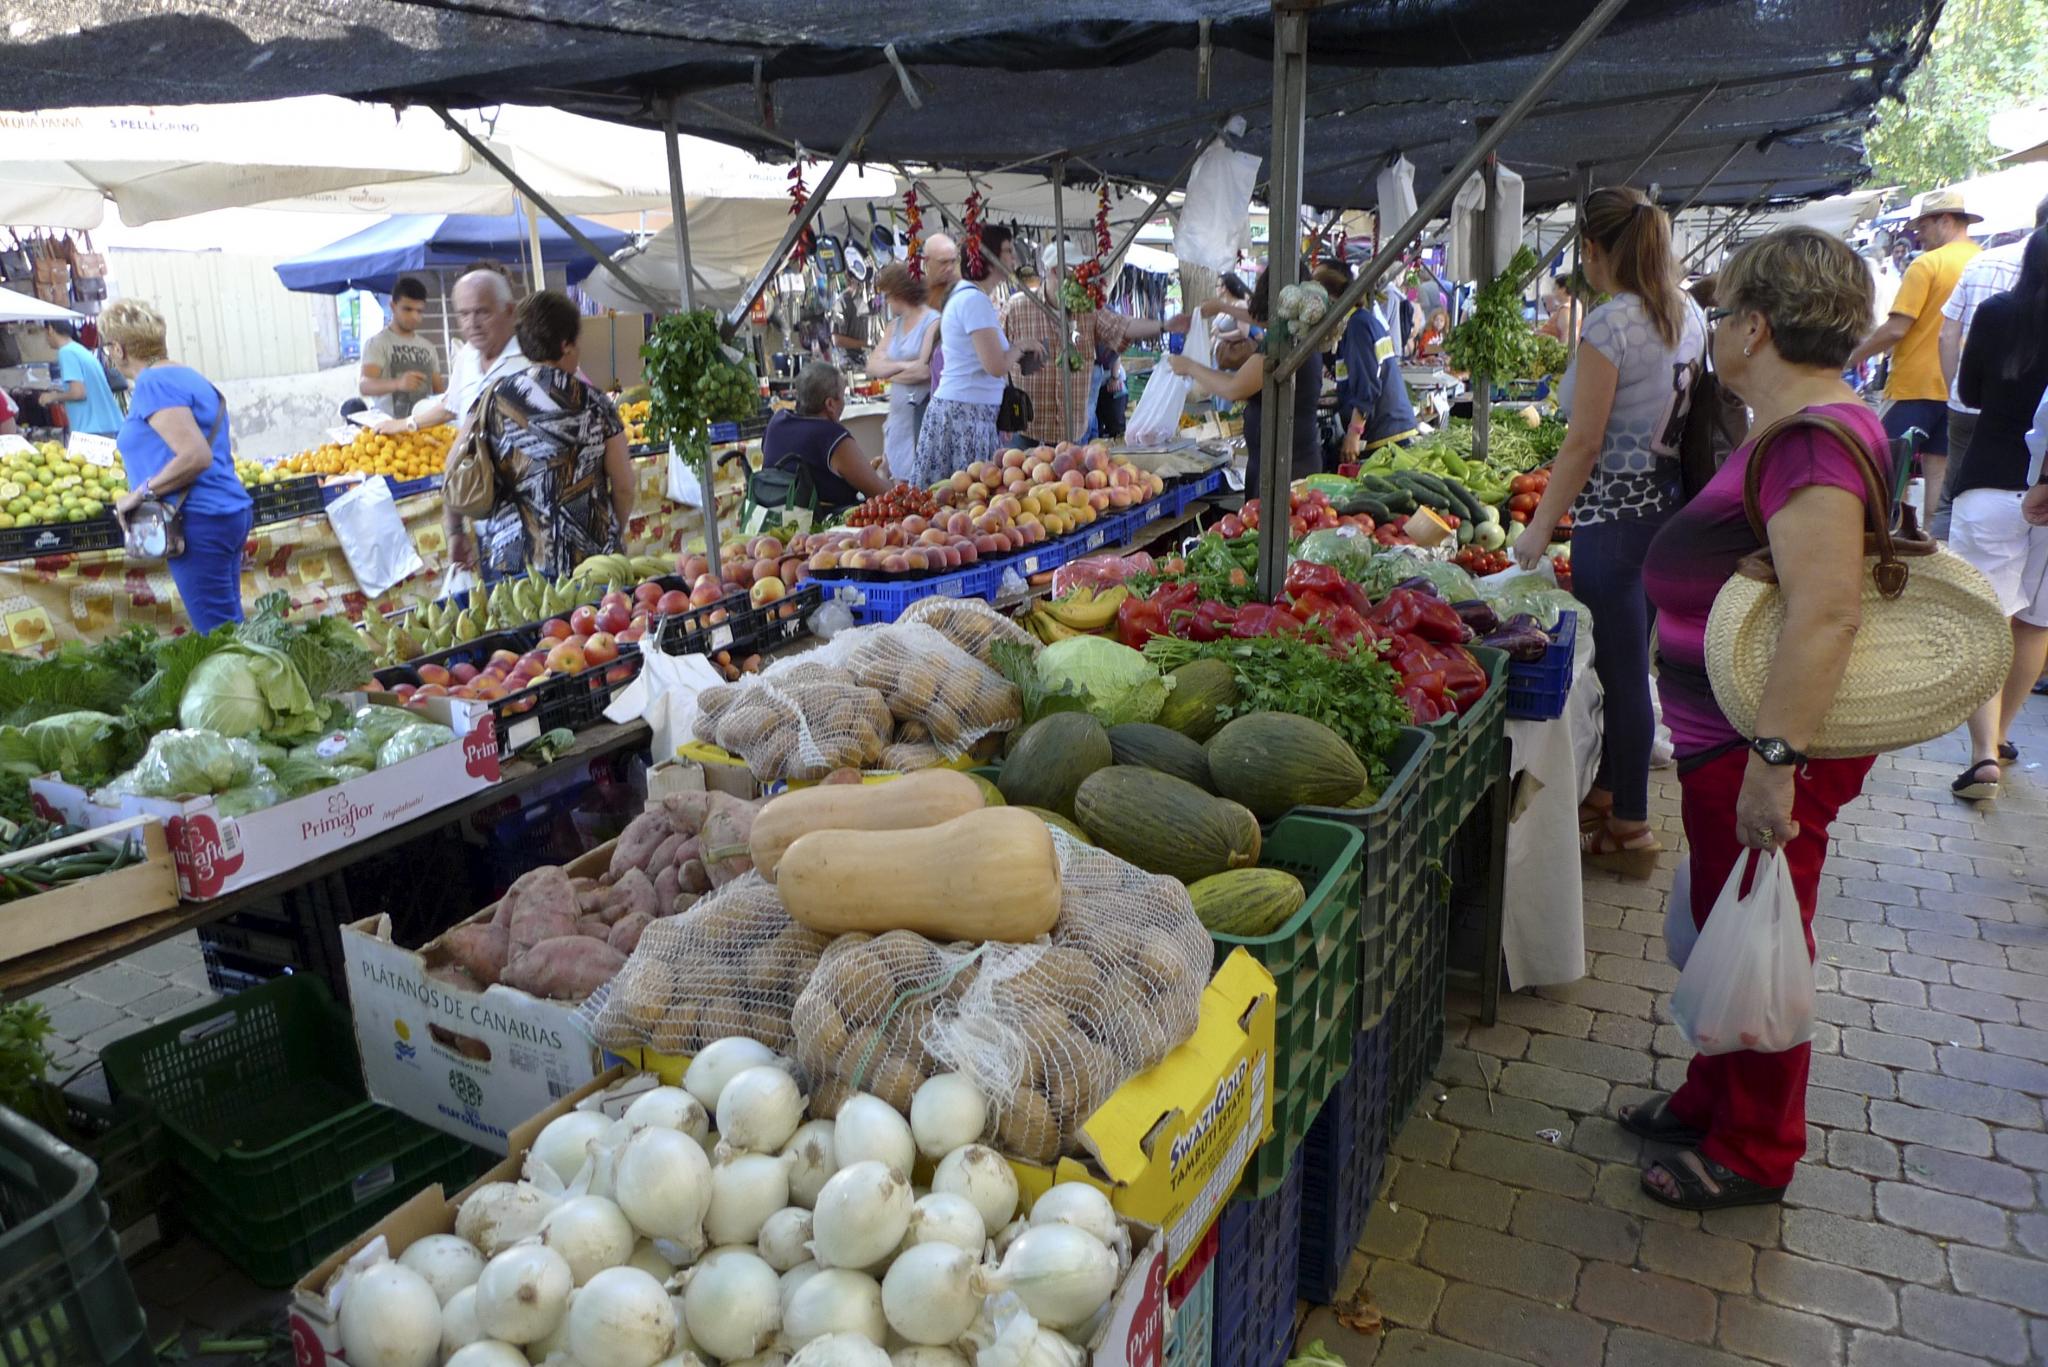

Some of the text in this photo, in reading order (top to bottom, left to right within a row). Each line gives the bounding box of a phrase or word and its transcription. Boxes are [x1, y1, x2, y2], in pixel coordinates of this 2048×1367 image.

[301, 803, 375, 841] Primaflor
[362, 959, 563, 1050] PLÁTANOS DE CANARIAS
[1169, 1124, 1217, 1192] TAMBUTI
